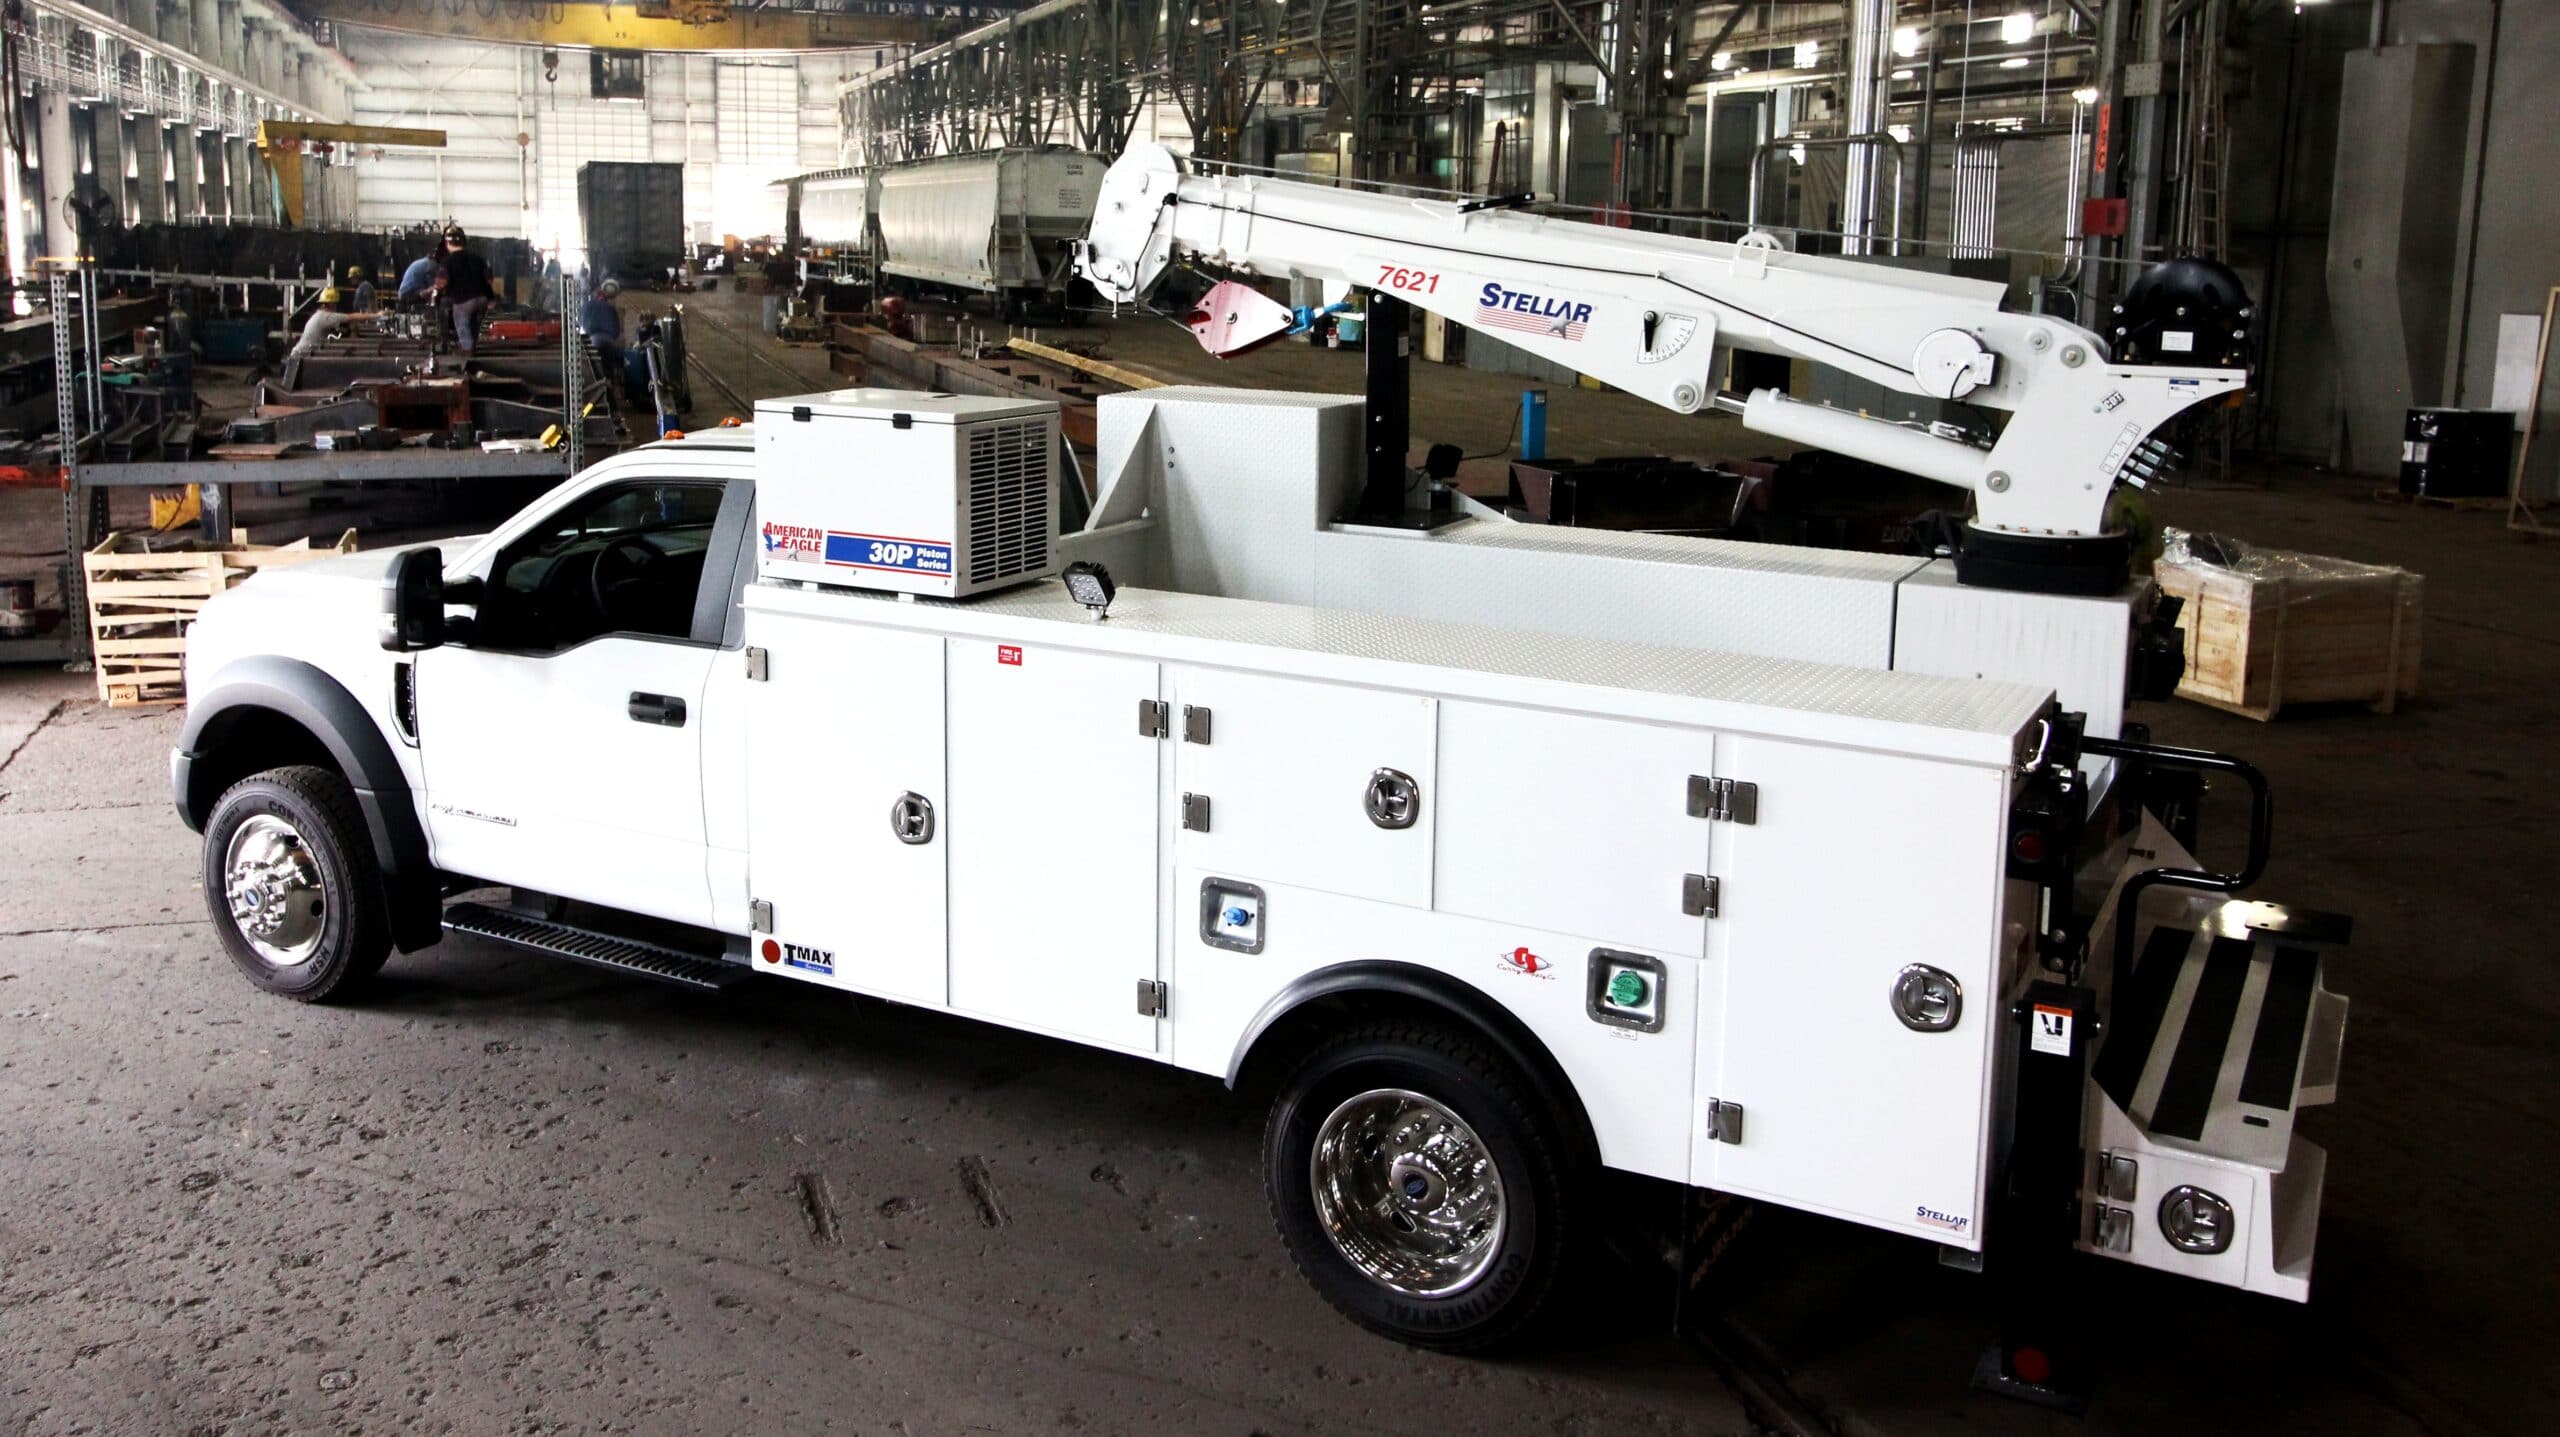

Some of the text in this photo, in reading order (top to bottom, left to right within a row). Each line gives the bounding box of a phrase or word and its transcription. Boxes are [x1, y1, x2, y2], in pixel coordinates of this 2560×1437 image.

[1377, 265, 1440, 294] 7621
[1480, 283, 1593, 323] STELLAR
[763, 521, 823, 539] AMERICAN
[782, 536, 822, 552] EAGLE
[869, 542, 914, 565] 30P
[916, 547, 947, 559] Piston
[916, 558, 947, 570] Series
[784, 943, 832, 966] TMAX
[1917, 1206, 1968, 1226] STELLAR
